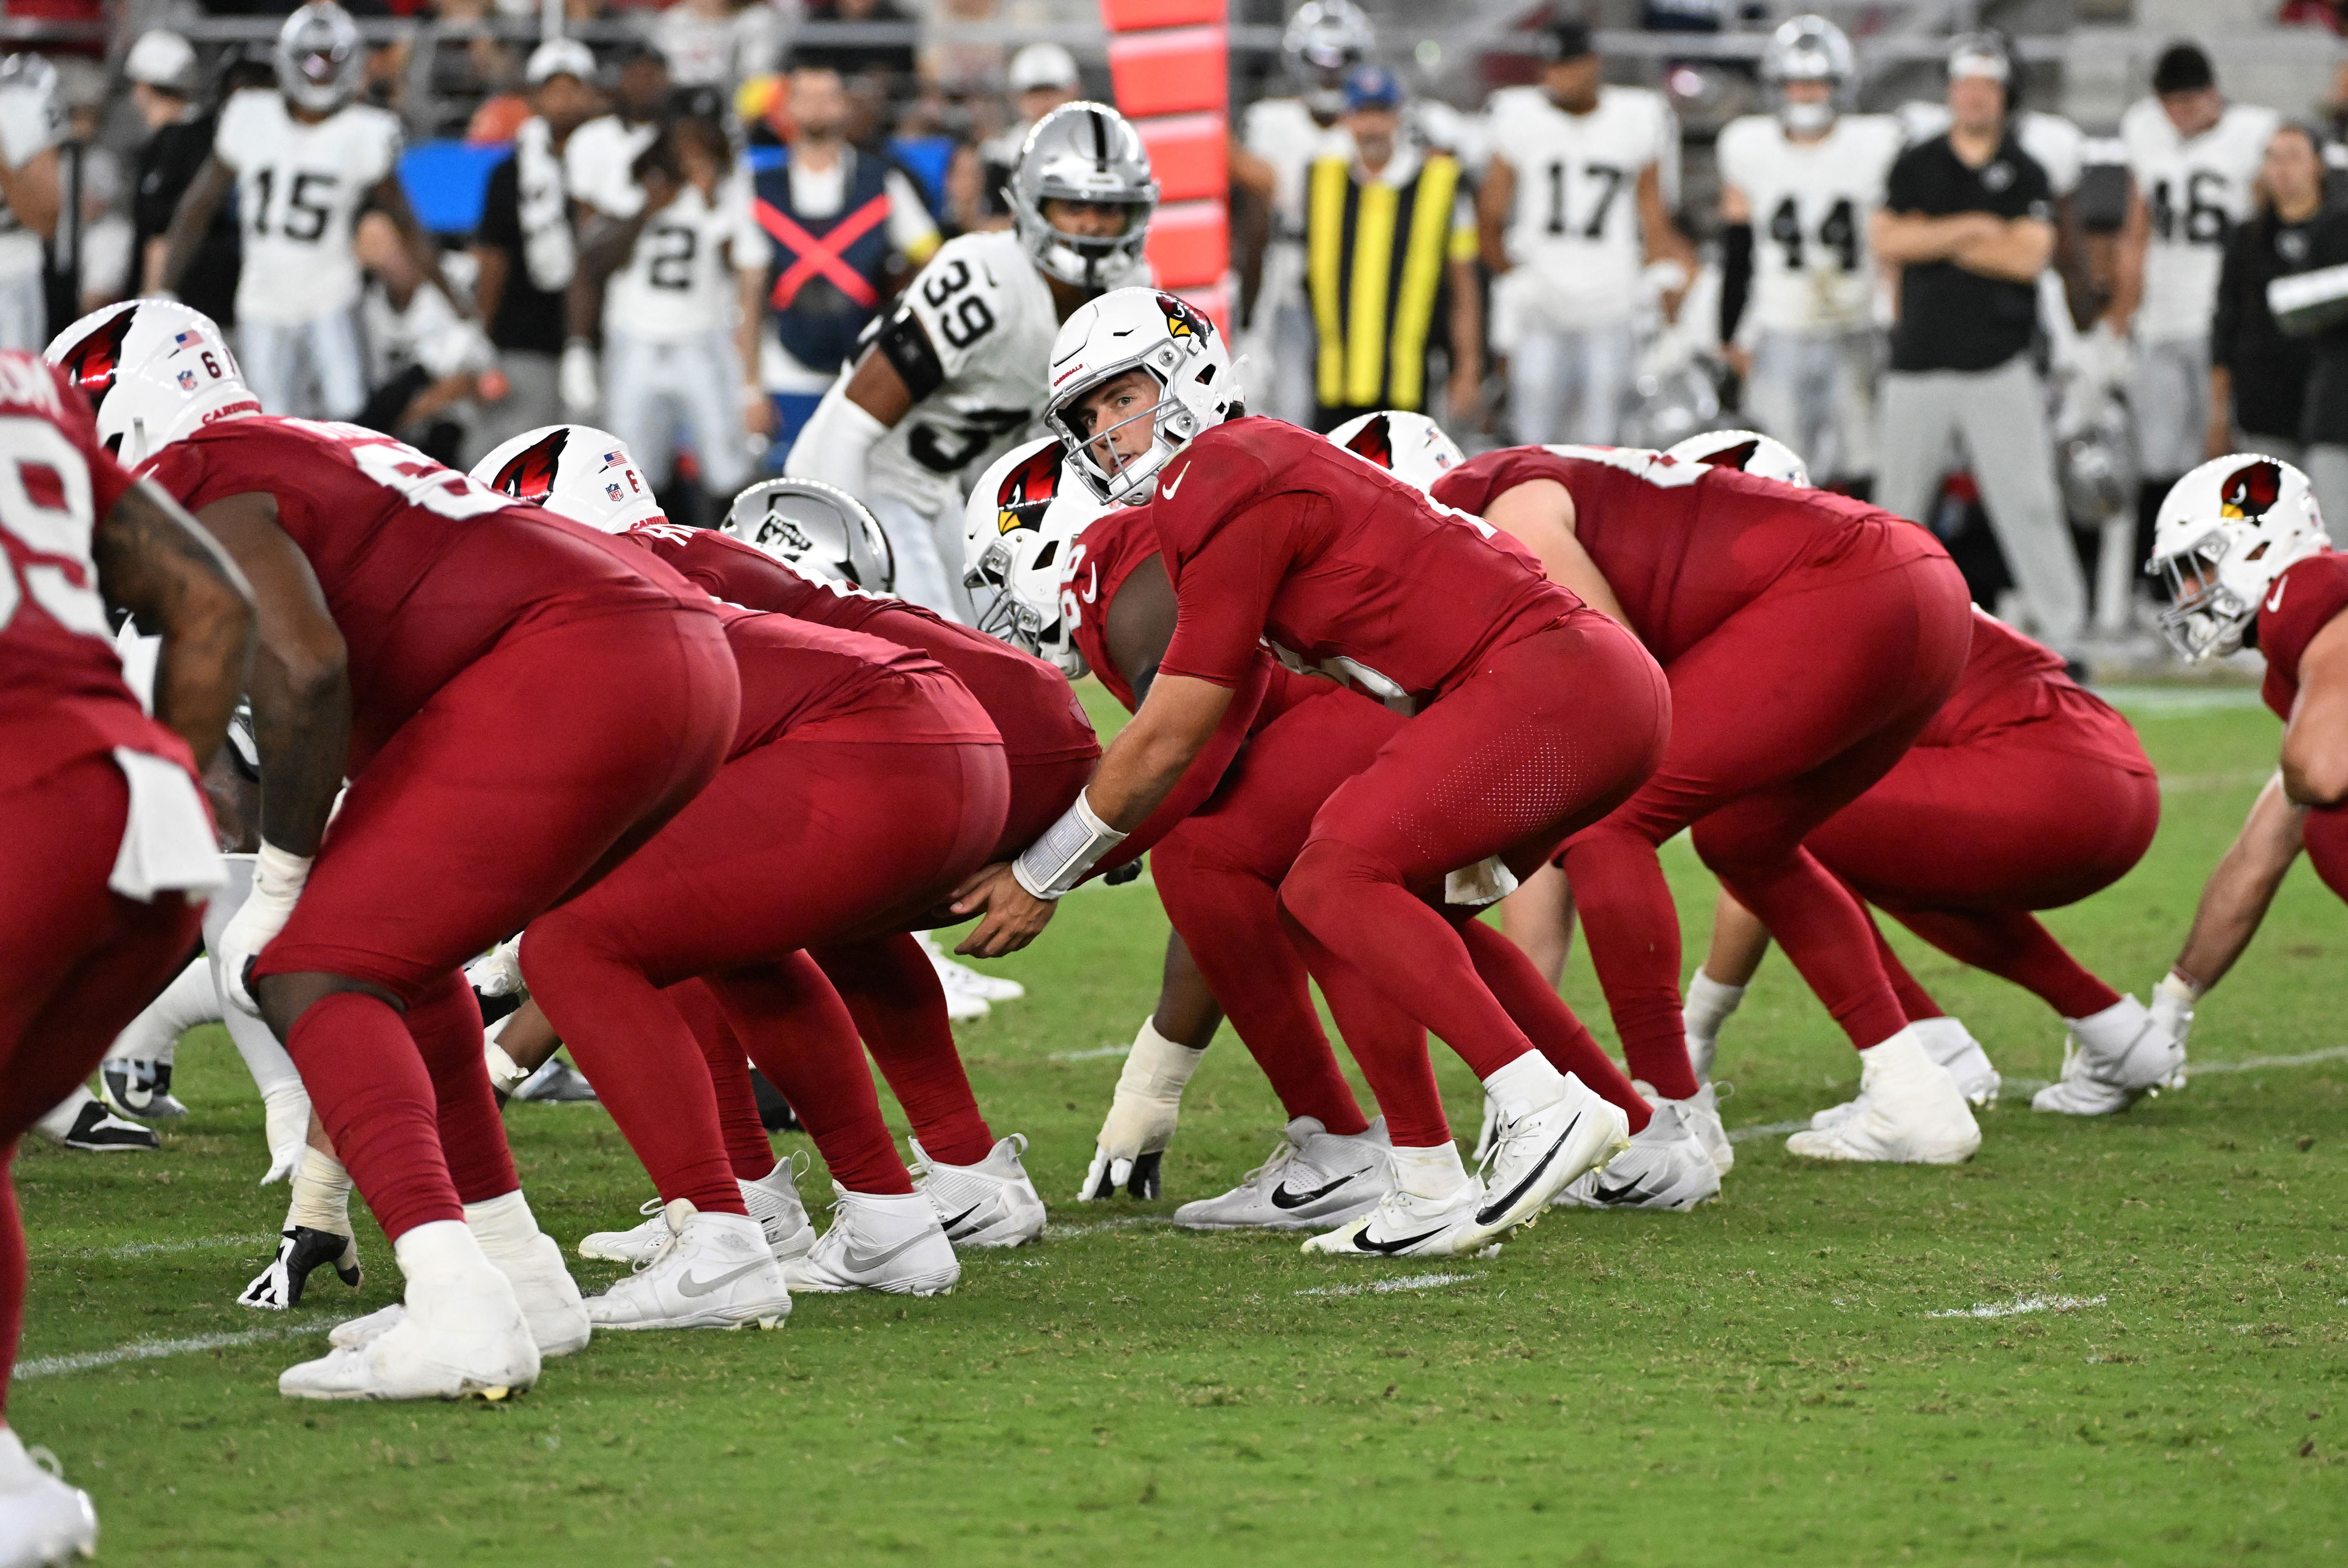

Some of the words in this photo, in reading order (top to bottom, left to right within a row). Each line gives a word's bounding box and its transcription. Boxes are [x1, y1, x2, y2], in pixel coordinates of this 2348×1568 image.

[254, 167, 338, 241] 15
[1546, 161, 1621, 239] 17
[1770, 197, 1855, 270] 44
[648, 226, 698, 292] 2
[923, 260, 994, 348] 39
